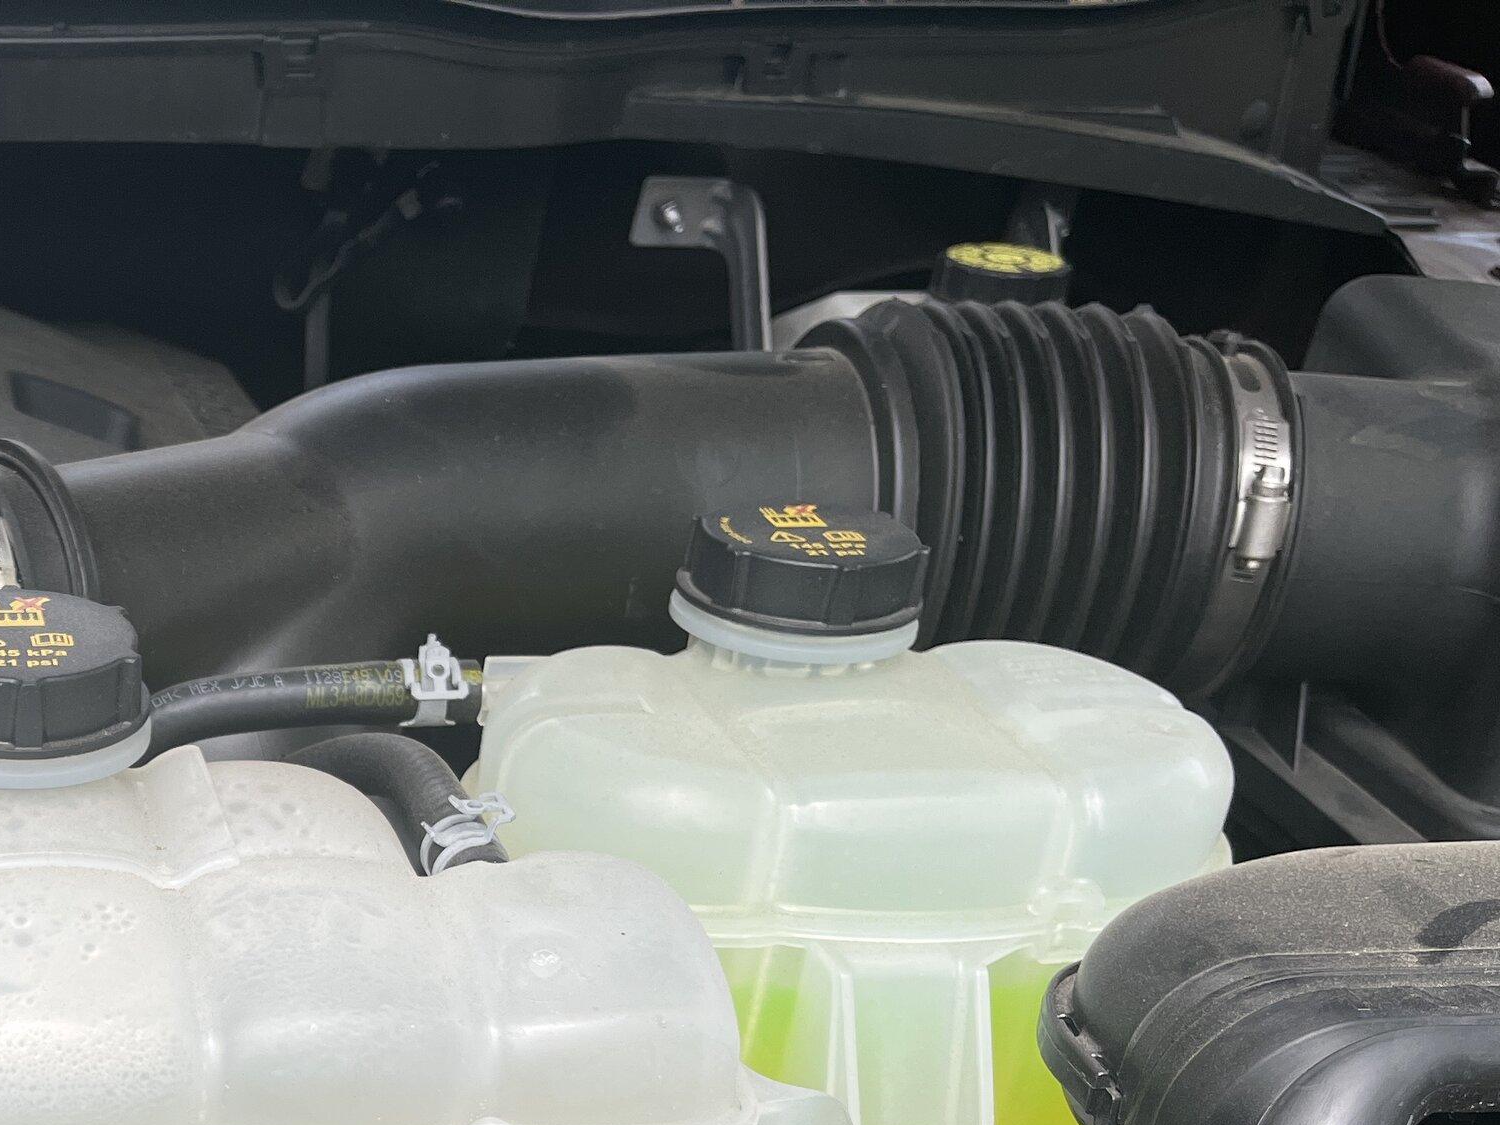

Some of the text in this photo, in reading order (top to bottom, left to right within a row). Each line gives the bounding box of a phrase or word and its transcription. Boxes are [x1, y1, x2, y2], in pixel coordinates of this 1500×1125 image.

[26, 649, 68, 657] kPa
[26, 658, 59, 668] psi
[188, 680, 221, 697] MEX
